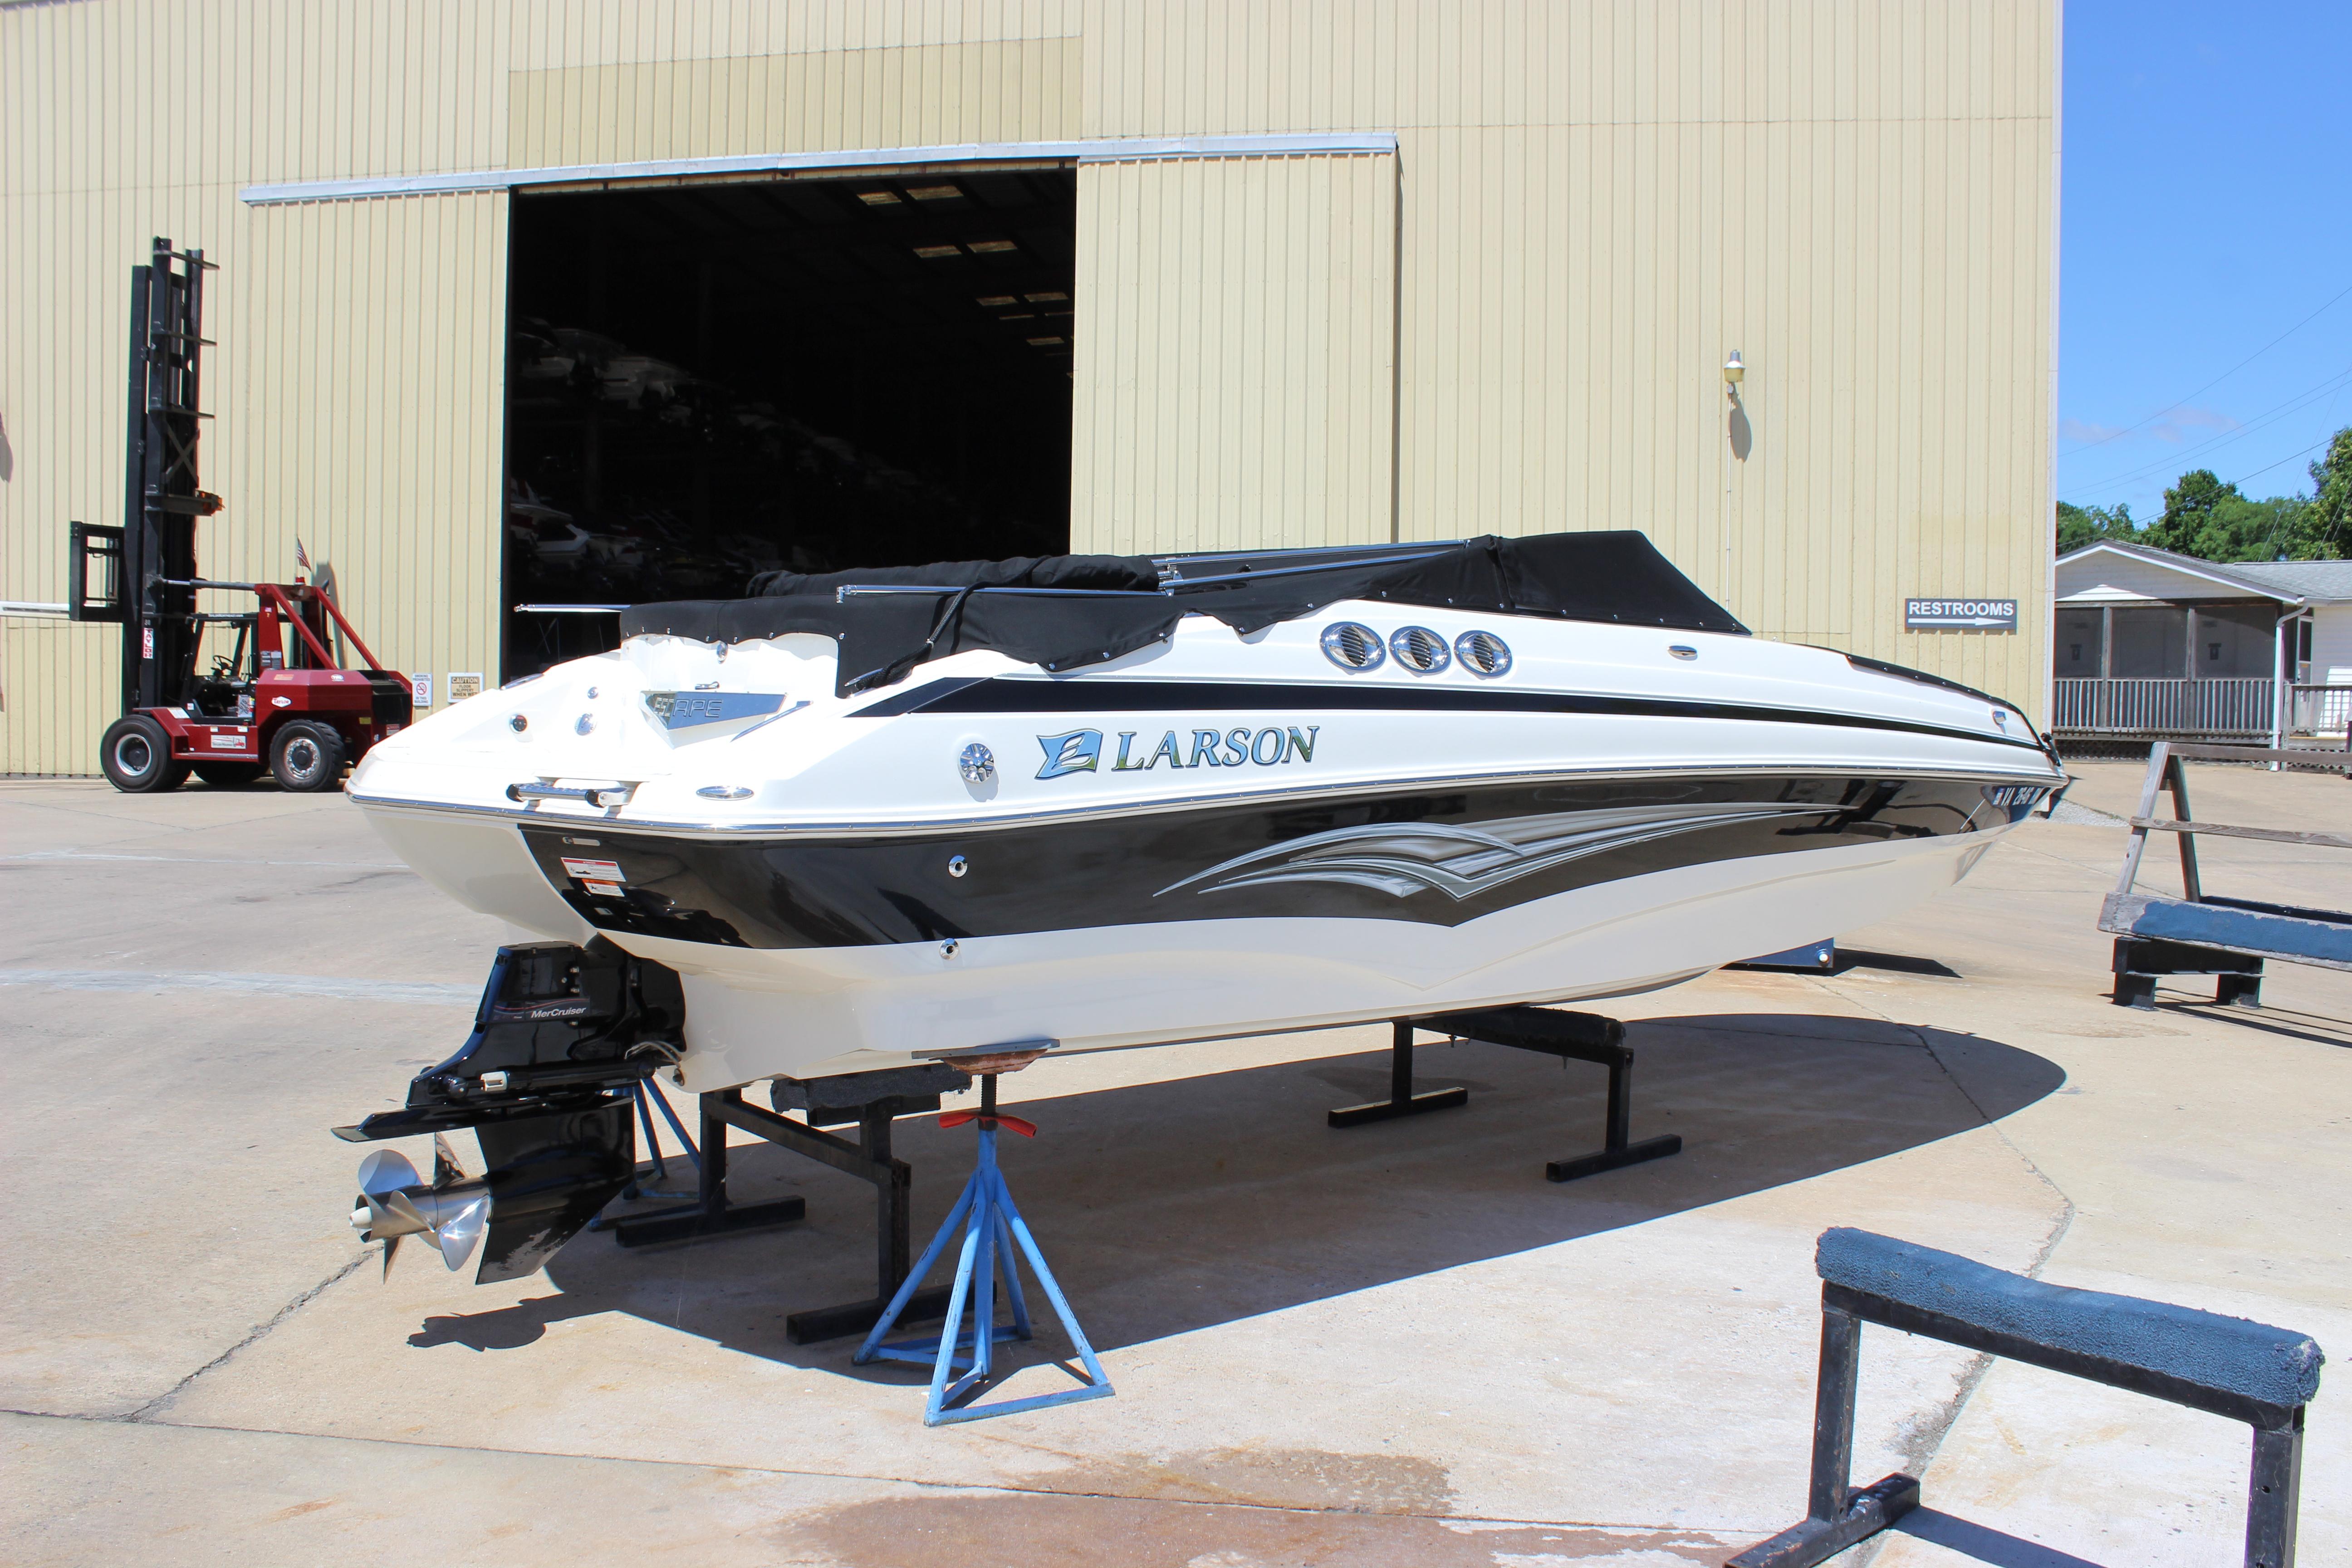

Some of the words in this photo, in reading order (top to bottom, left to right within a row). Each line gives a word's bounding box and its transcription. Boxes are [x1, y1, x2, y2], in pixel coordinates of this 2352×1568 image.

[1908, 602, 2014, 616] RESTROOMS
[145, 628, 153, 658] TAYLOR
[653, 697, 723, 718] ESCAPE
[1111, 726, 1320, 771] LARSON
[2001, 787, 2015, 806] VA
[530, 1007, 587, 1019] MerCruiser
